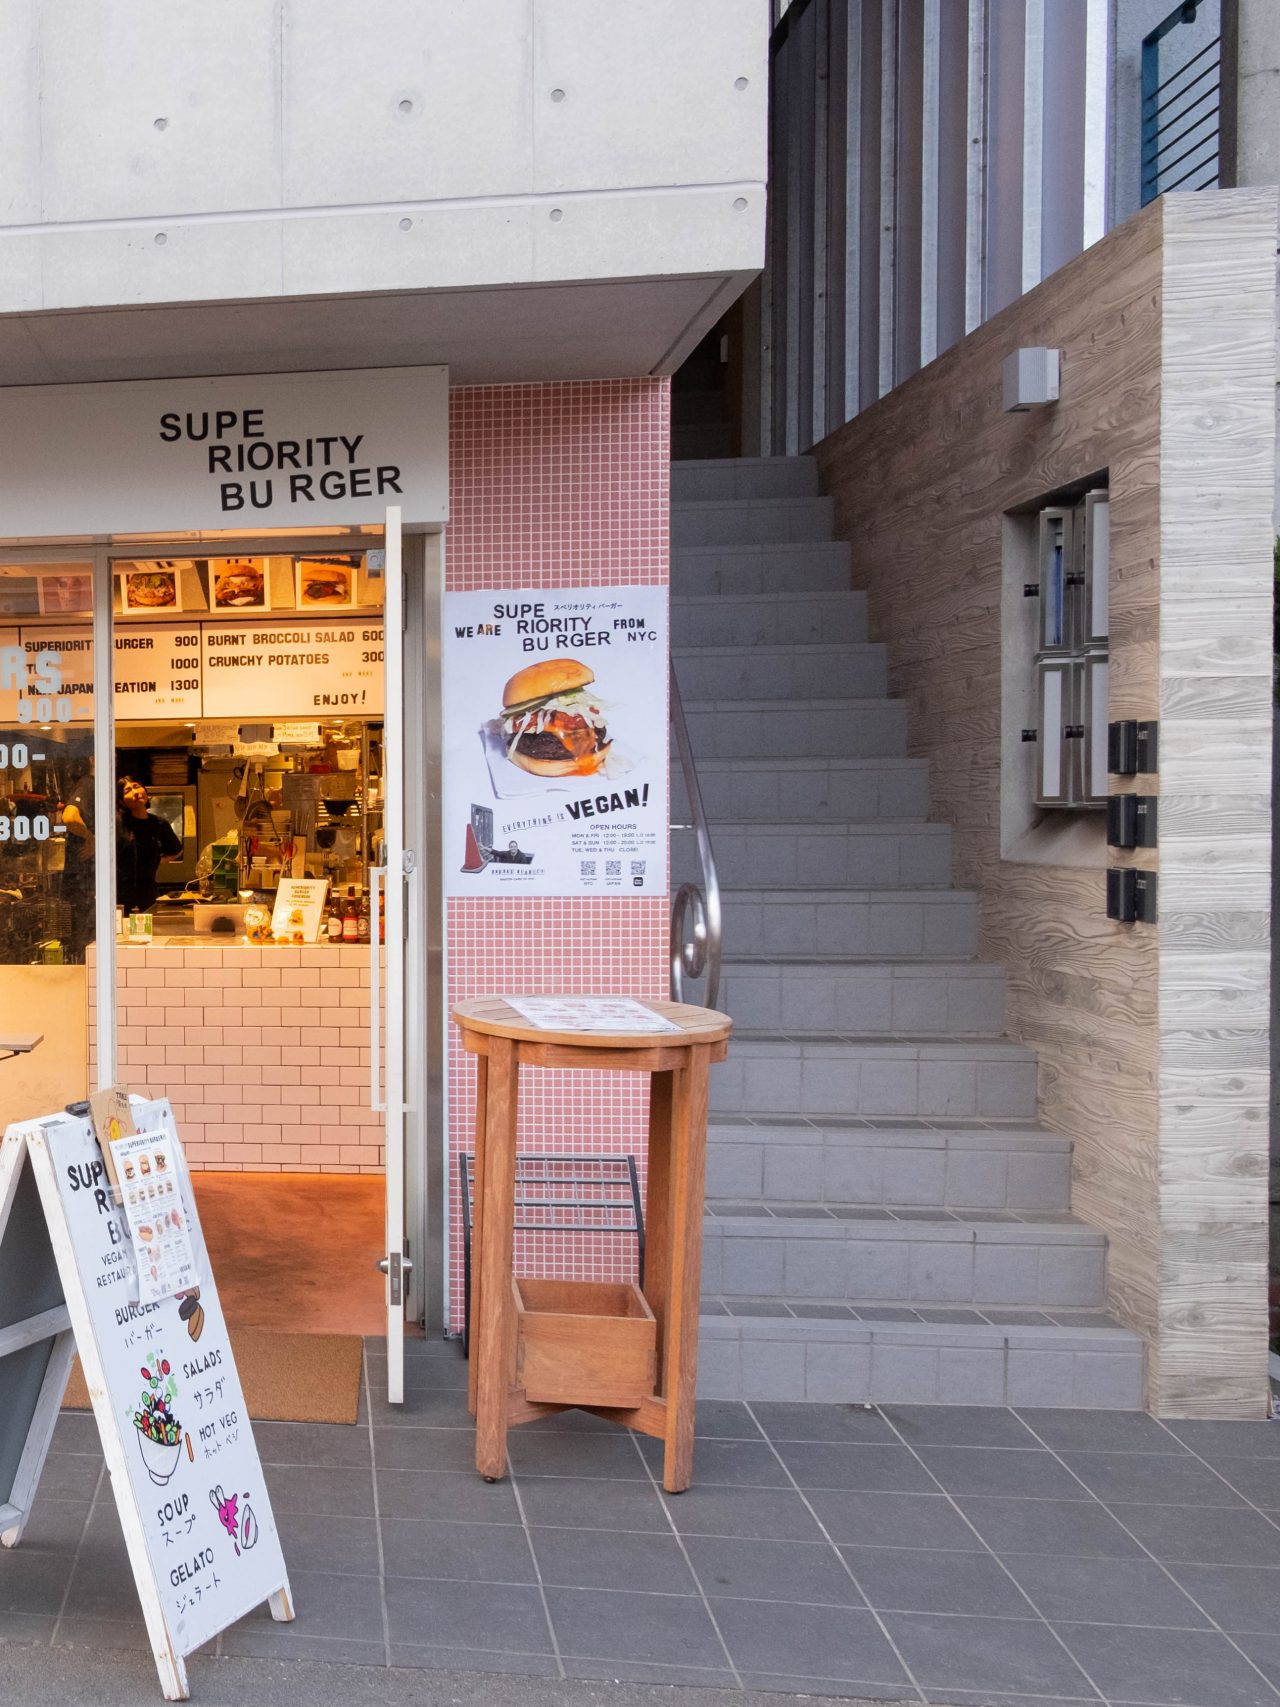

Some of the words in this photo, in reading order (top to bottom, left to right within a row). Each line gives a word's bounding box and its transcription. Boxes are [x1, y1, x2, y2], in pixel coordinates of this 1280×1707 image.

[159, 409, 265, 442] SUPE
[208, 435, 364, 473] RIORITY
[494, 604, 544, 619] SUPE
[455, 626, 473, 638] WE
[477, 624, 501, 636] ARE
[517, 616, 592, 634] RIORITY
[613, 618, 645, 630] FROM
[25, 640, 94, 652] SUPERIORIT
[114, 638, 154, 650] URGER
[174, 636, 198, 647] 900
[208, 634, 247, 646] BURNT
[253, 632, 310, 645] BROCCOLI
[315, 631, 355, 643] SALAD
[627, 631, 657, 642] NYC
[170, 658, 198, 669] 1000
[208, 655, 262, 667] CRUNCHY
[268, 653, 329, 666] POTATOES
[57, 683, 94, 695] JAPAN
[114, 681, 156, 693] EATION
[170, 680, 199, 691] 1300
[313, 690, 366, 706] ENJOY!
[502, 815, 552, 832] EVERYTHING
[565, 783, 649, 821] VEGAN!
[67, 1160, 103, 1192] SUP
[183, 1349, 222, 1380] SALADS
[199, 1421, 217, 1442] HOT
[219, 1411, 238, 1432] VEG
[157, 1493, 189, 1527] SOUP
[162, 1514, 196, 1547] スープ
[170, 1547, 215, 1588] GELATO
